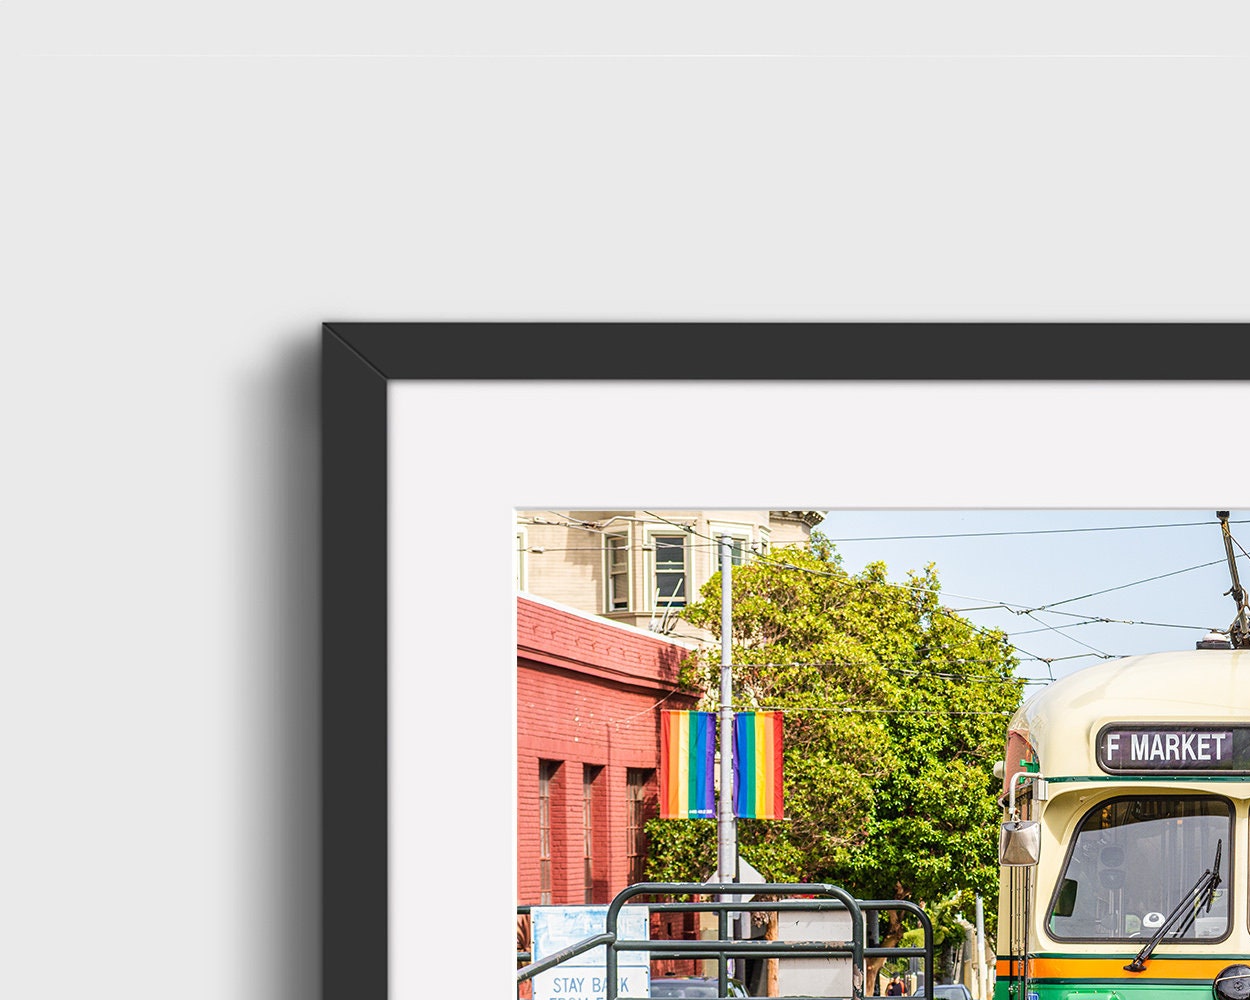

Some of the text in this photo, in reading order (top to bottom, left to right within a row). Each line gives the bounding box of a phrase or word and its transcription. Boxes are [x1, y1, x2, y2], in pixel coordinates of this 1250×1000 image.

[1107, 734, 1120, 761] F
[1130, 734, 1226, 761] MARKET
[553, 977, 585, 993] STAY
